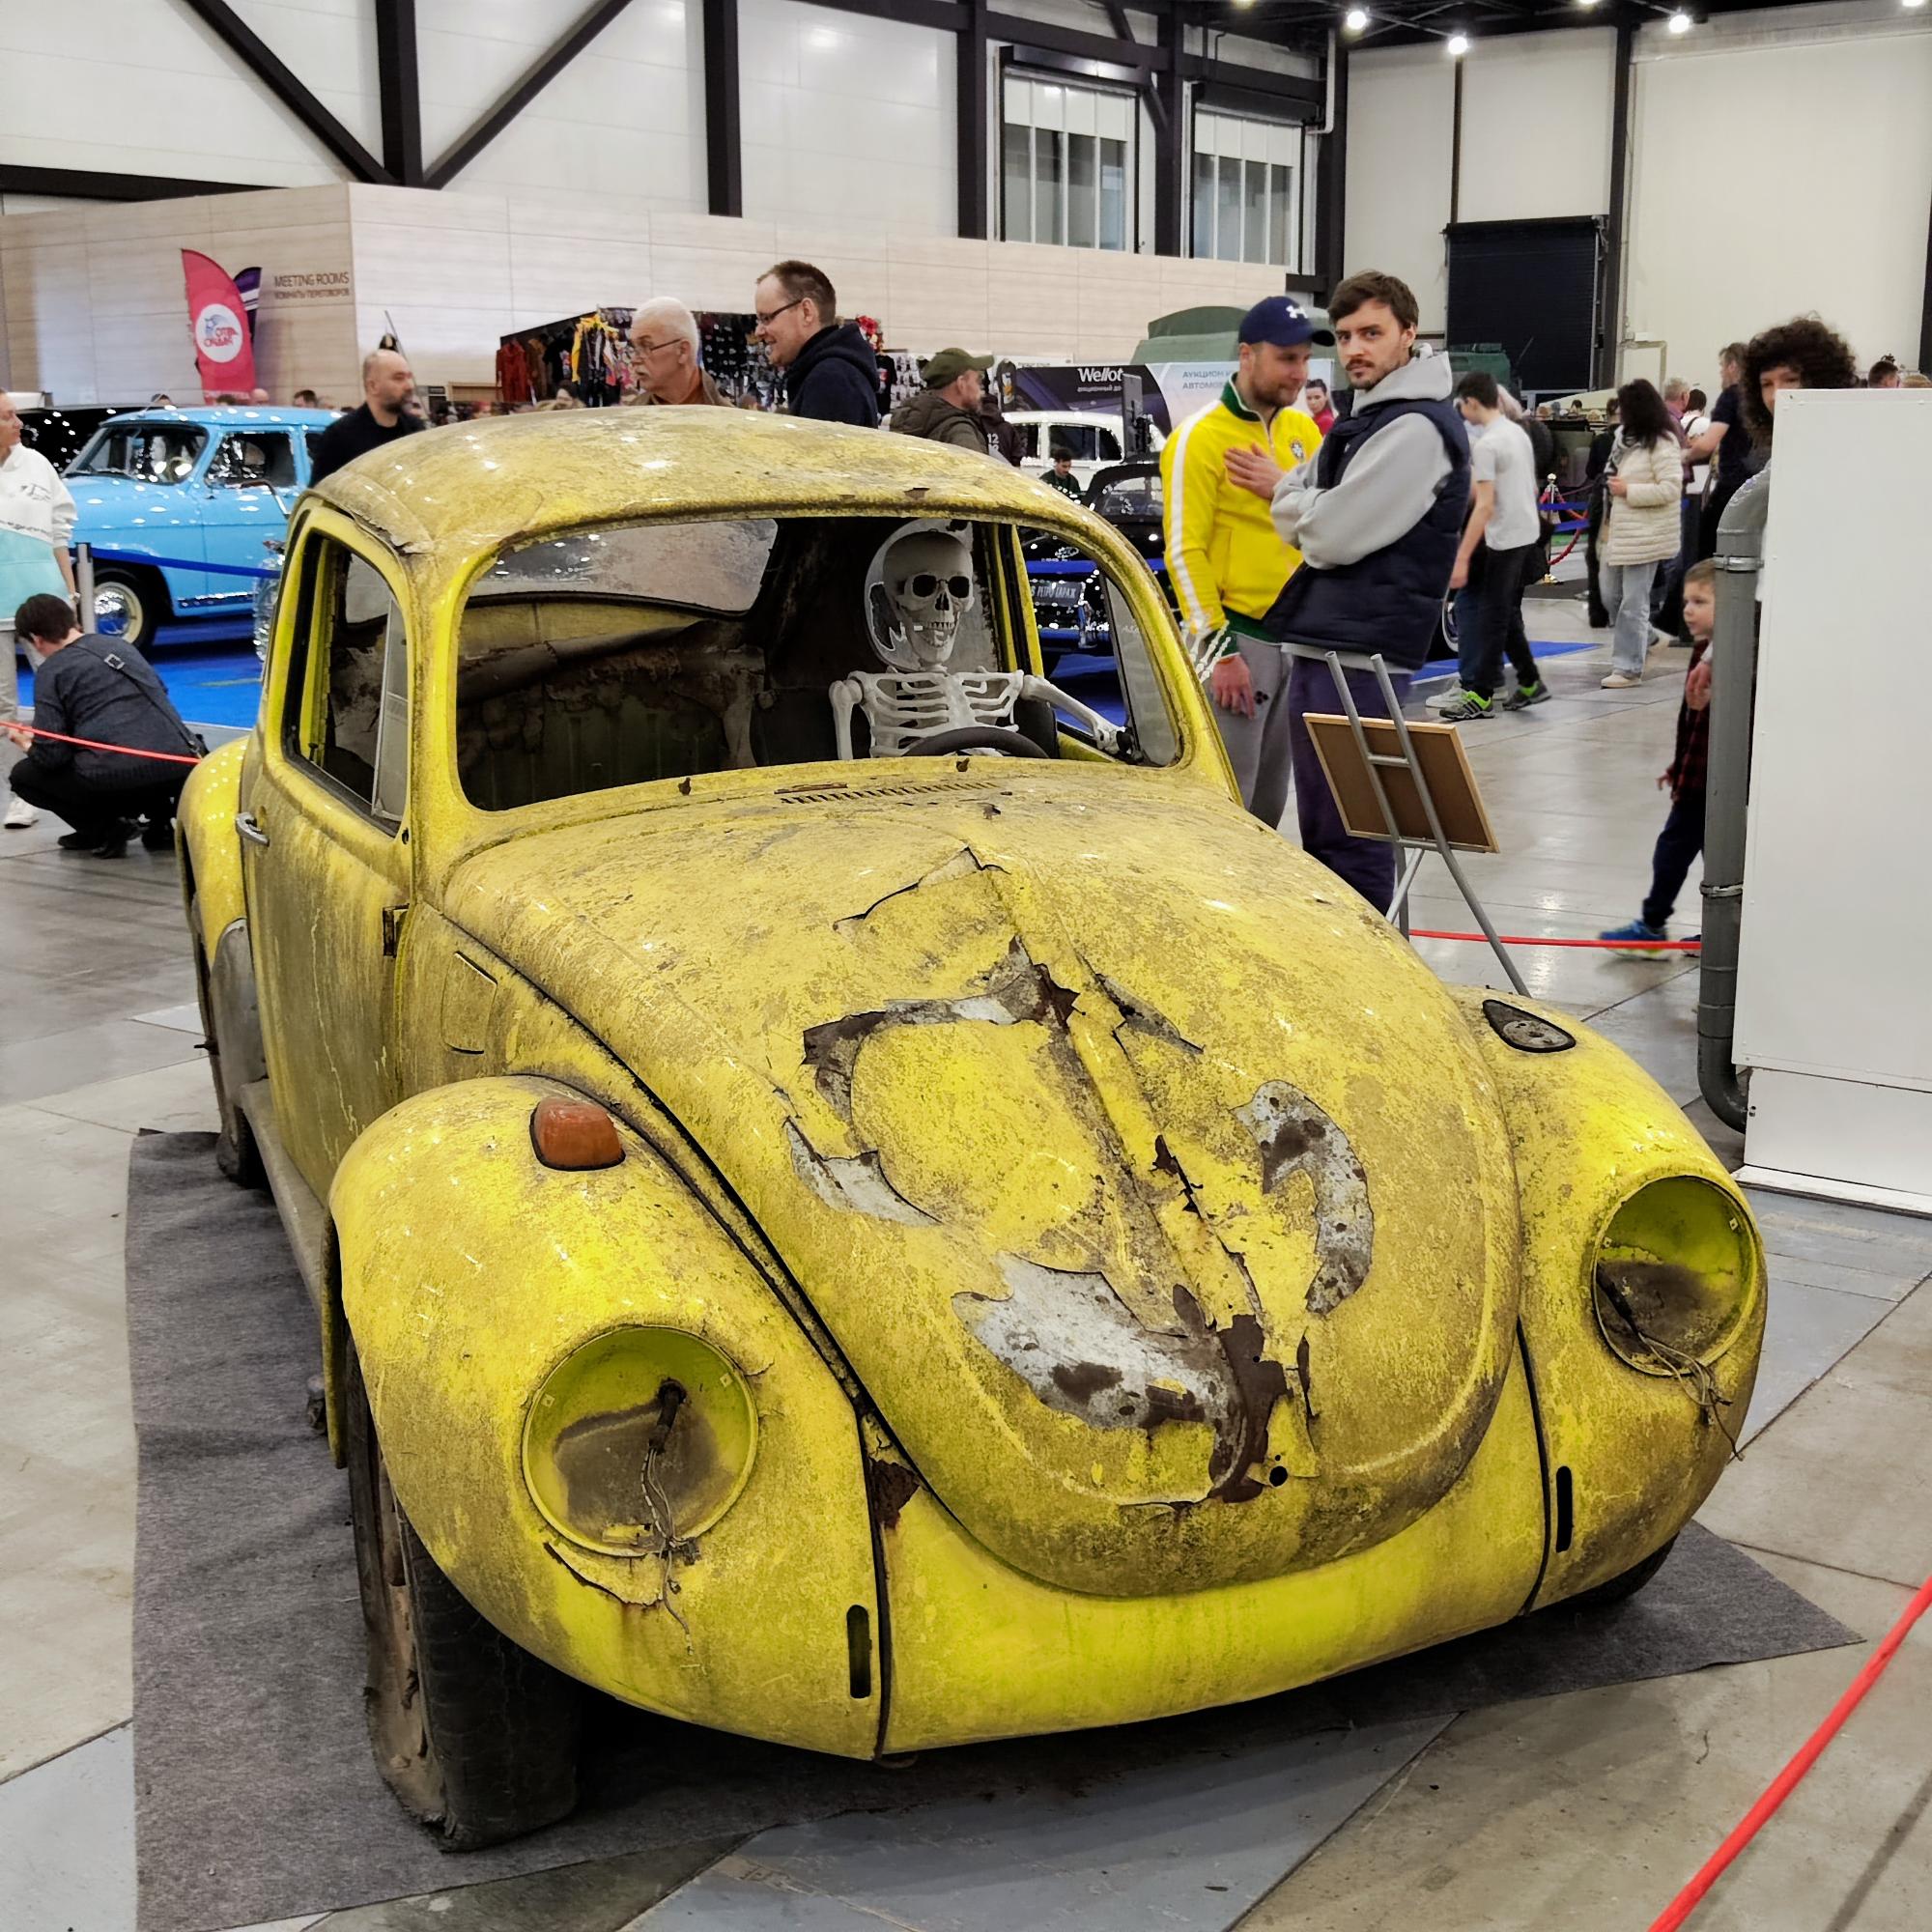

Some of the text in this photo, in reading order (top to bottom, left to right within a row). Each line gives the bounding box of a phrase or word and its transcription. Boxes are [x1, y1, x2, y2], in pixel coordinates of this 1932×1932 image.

[274, 271, 350, 287] MEETING ROOMS
[1077, 367, 1124, 383] Wellot
[986, 433, 1000, 444] 12
